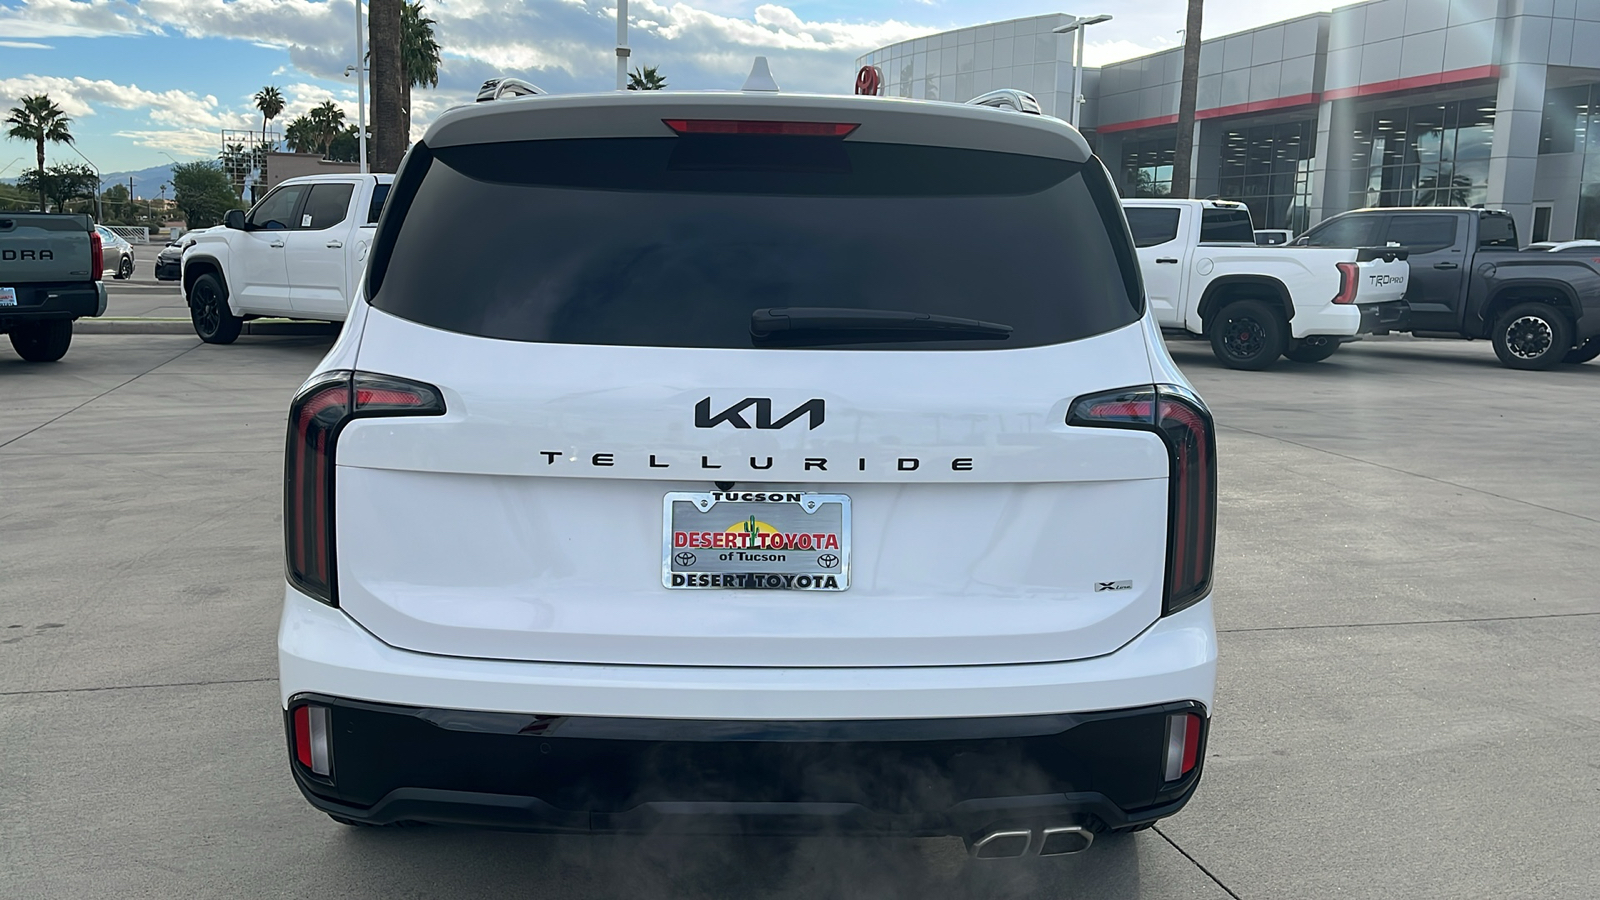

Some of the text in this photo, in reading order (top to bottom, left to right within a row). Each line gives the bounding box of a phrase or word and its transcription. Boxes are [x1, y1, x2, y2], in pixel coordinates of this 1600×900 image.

[694, 396, 826, 431] KIA
[539, 450, 974, 472] TELLURIDE
[712, 492, 801, 502] TUCSON
[674, 531, 839, 550] DESERT TOYOTA
[719, 551, 786, 562] of Tucson
[672, 573, 840, 589] DESERT TOYOTA
